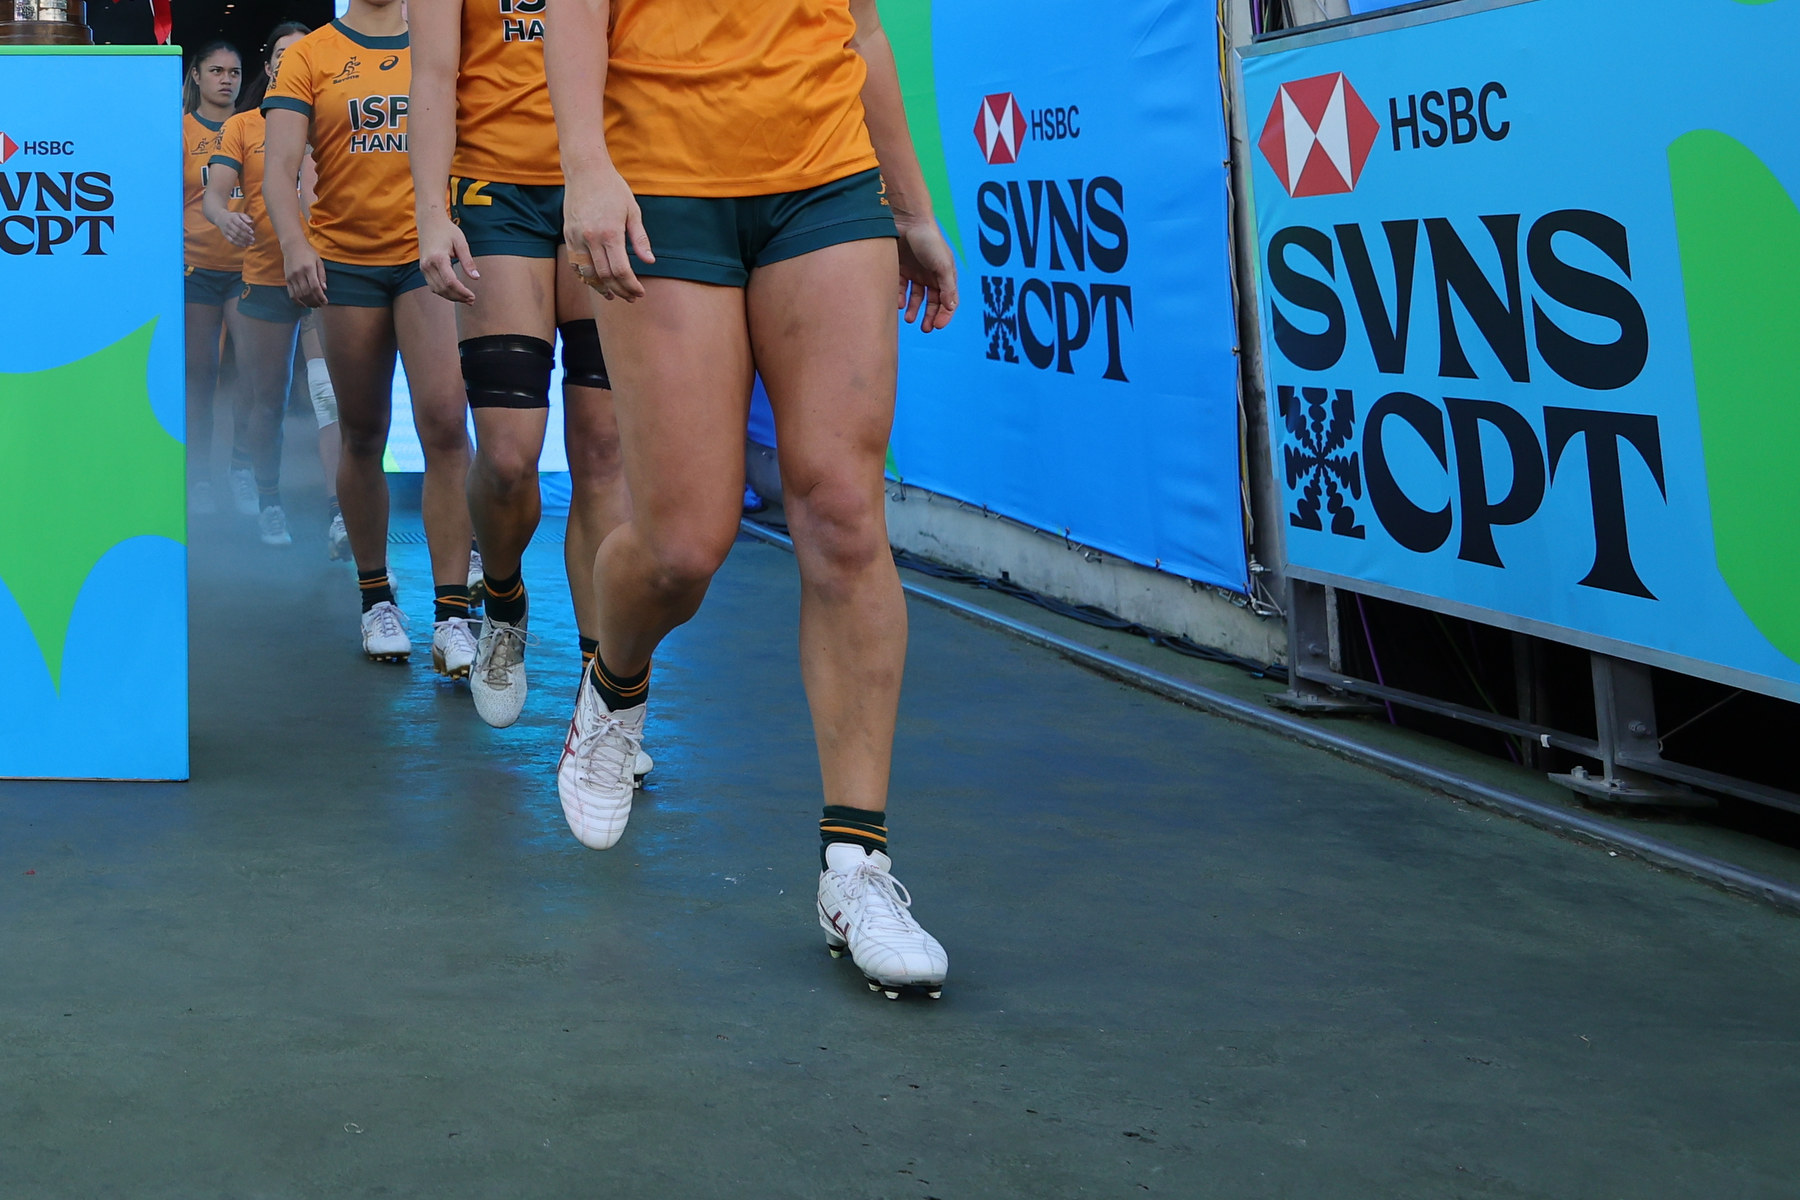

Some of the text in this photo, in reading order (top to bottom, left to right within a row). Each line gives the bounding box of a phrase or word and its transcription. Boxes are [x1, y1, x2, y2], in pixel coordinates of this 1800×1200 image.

[24, 141, 75, 156] HSBC
[347, 95, 410, 133] ISP
[350, 133, 408, 154] HAN
[1031, 105, 1080, 141] HSBC
[1389, 81, 1511, 151] HSBC
[977, 176, 1129, 273] SVNS
[1017, 278, 1134, 383] CPT
[1267, 208, 1649, 391] SVNS
[1362, 391, 1668, 602] CPT
